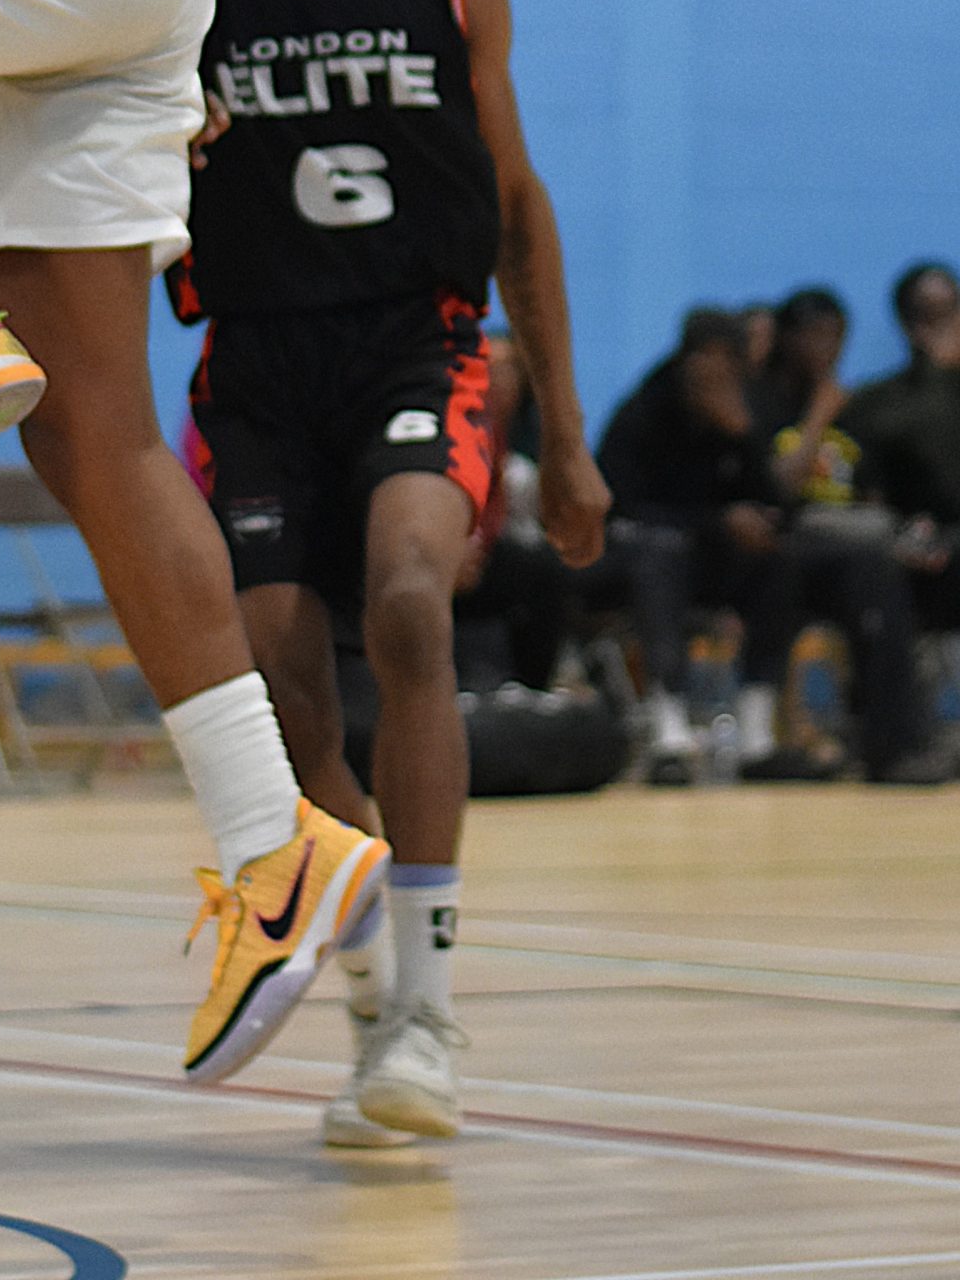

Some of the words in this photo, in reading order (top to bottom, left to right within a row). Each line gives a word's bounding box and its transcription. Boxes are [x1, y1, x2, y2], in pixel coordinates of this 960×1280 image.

[230, 29, 408, 62] LONDON
[215, 54, 441, 116] ELITE
[293, 143, 394, 227] 6
[384, 409, 439, 443] 6
